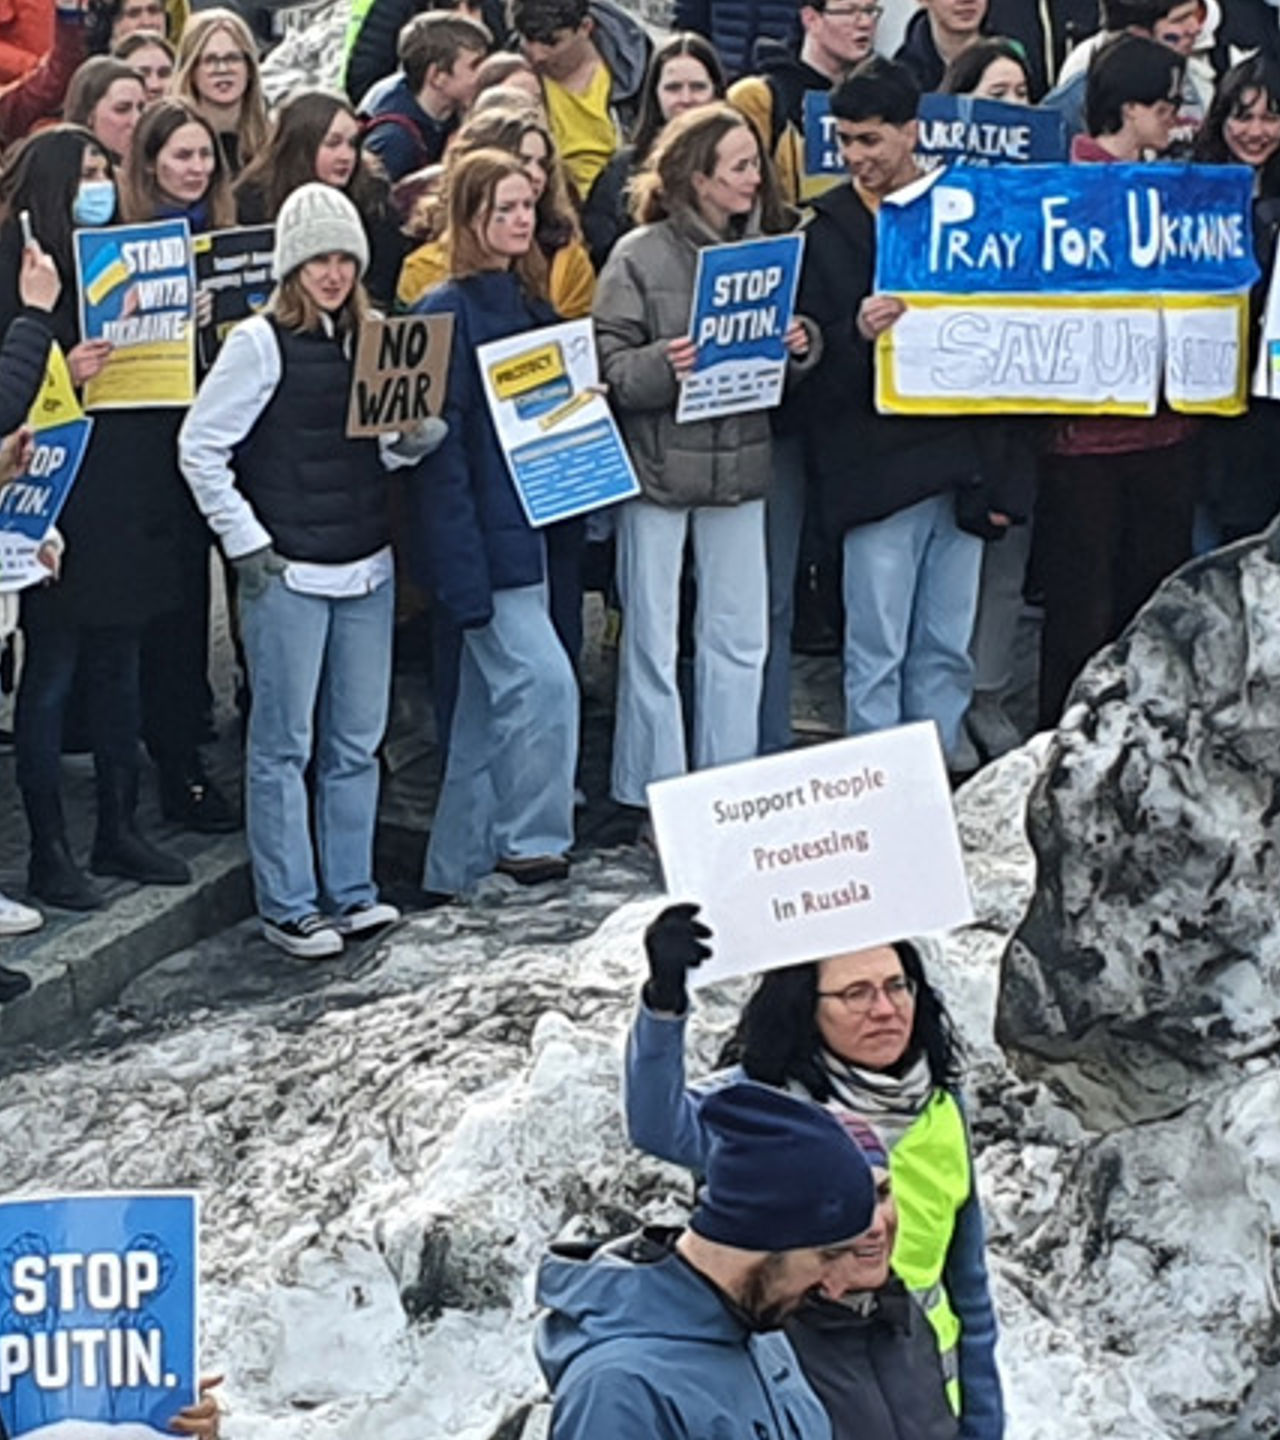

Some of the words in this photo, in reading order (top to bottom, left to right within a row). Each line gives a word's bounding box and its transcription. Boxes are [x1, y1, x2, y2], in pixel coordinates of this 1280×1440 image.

[919, 119, 1031, 160] UKRAINE
[929, 186, 1022, 272] PRAY
[1042, 196, 1110, 272] FOR
[121, 235, 185, 274] STAND
[136, 274, 188, 311] WITH
[712, 266, 782, 307] STOP
[378, 320, 428, 371] NO
[698, 305, 782, 348] PUTIN.
[930, 311, 1086, 390] SAVE
[357, 372, 431, 427] WAR
[29, 445, 67, 477] OP
[712, 786, 806, 825] Support
[810, 767, 885, 802] People
[752, 830, 870, 872] Protesting
[772, 898, 797, 922] In
[801, 880, 871, 914] Russia
[12, 1250, 159, 1316] STOP
